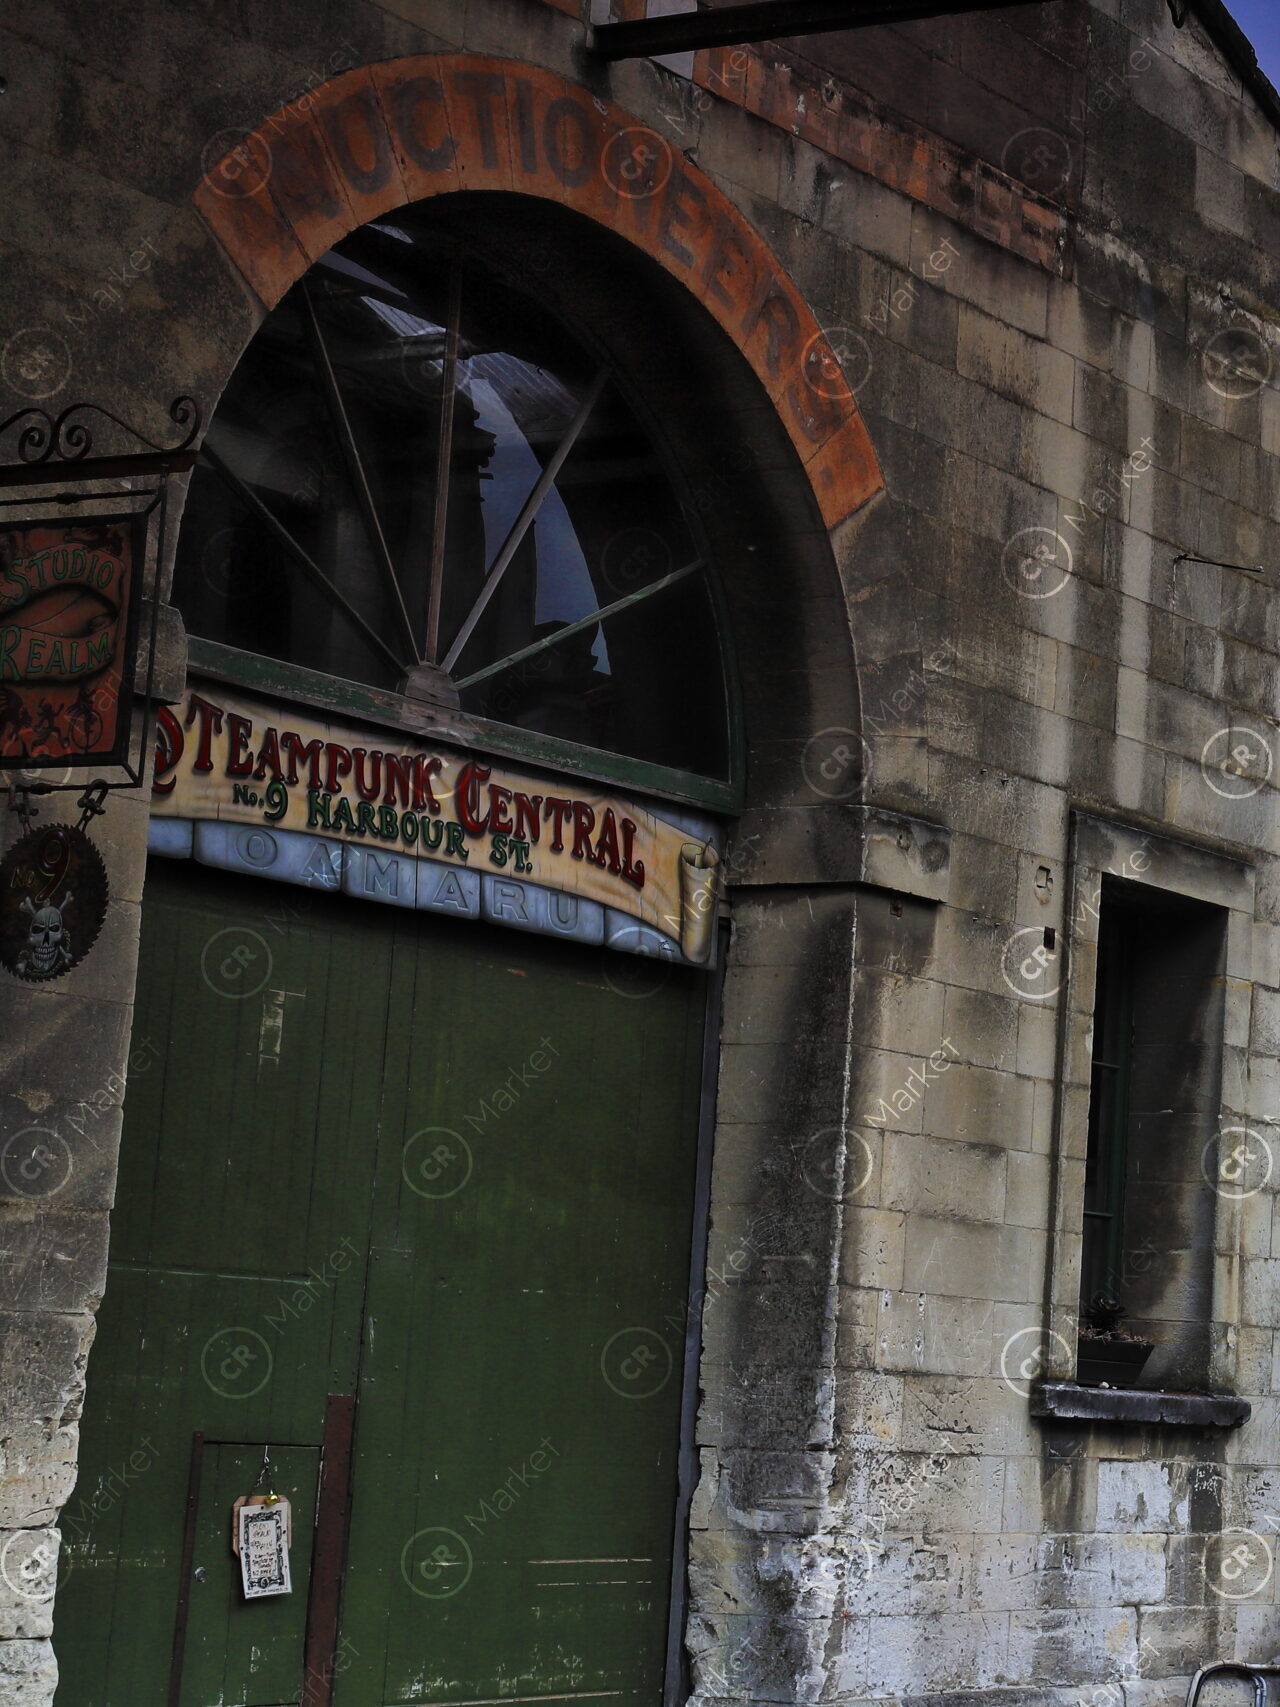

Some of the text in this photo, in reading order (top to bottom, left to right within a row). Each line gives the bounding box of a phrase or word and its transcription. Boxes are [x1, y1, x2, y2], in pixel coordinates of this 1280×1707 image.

[6, 549, 115, 607] STUDIO
[0, 625, 114, 680] REALM
[35, 827, 71, 904] 9
[308, 790, 469, 859] HARBOUR
[490, 834, 533, 873] ST.
[456, 762, 645, 890] CENTRAL
[236, 828, 580, 934] OAMARU
